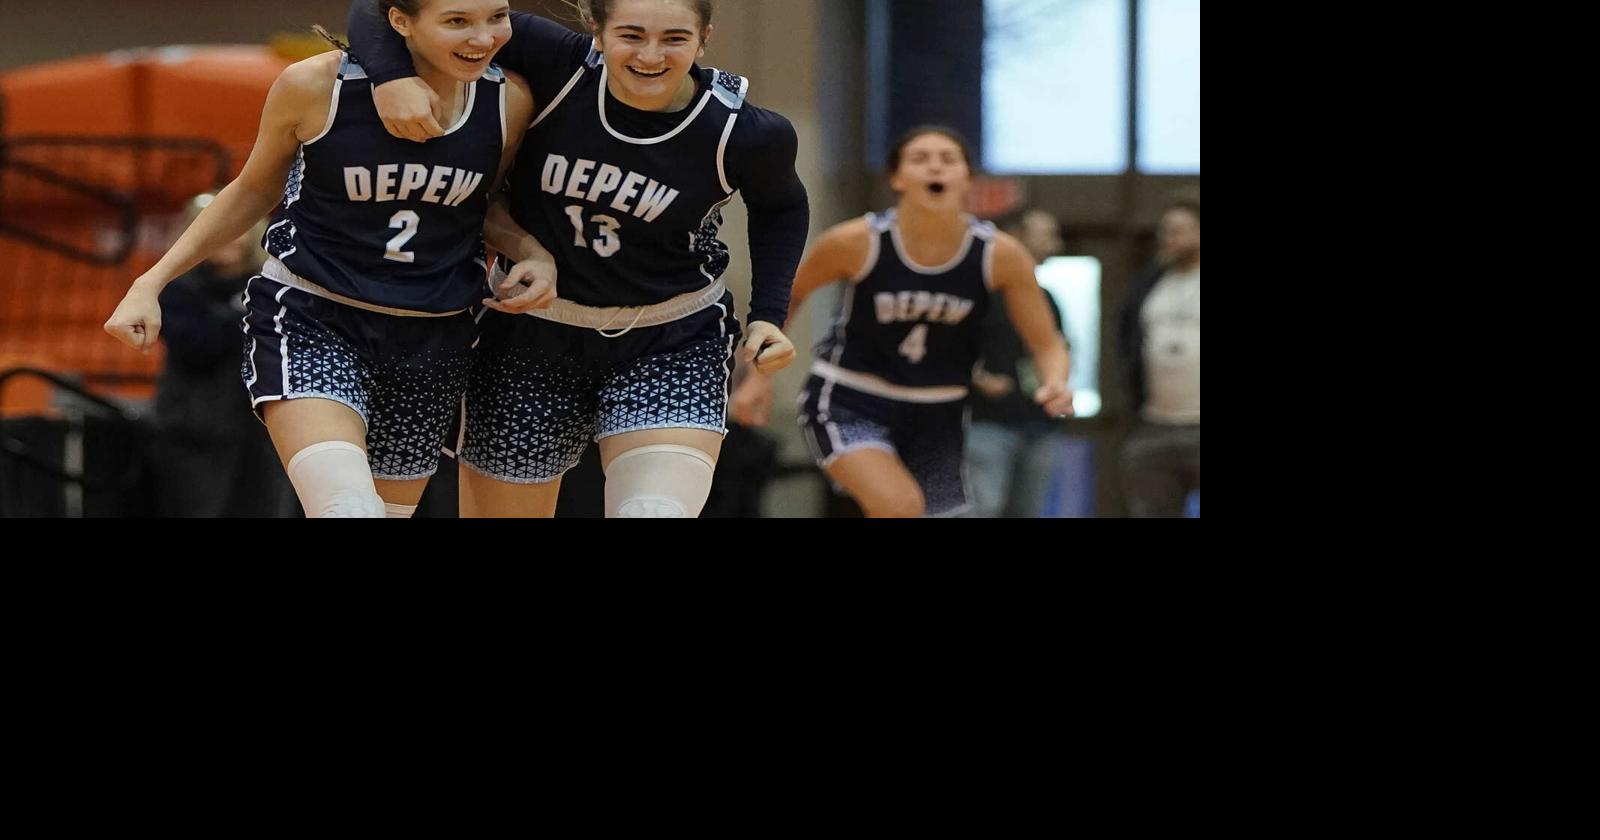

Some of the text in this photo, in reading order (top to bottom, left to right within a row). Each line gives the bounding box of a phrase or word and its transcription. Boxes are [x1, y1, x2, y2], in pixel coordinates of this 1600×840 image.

[344, 164, 483, 206] DEPEW
[541, 153, 680, 222] DEPEW
[383, 210, 420, 263] 2
[564, 205, 622, 258] 13
[874, 291, 974, 324] DEPEW
[899, 324, 928, 363] 4
